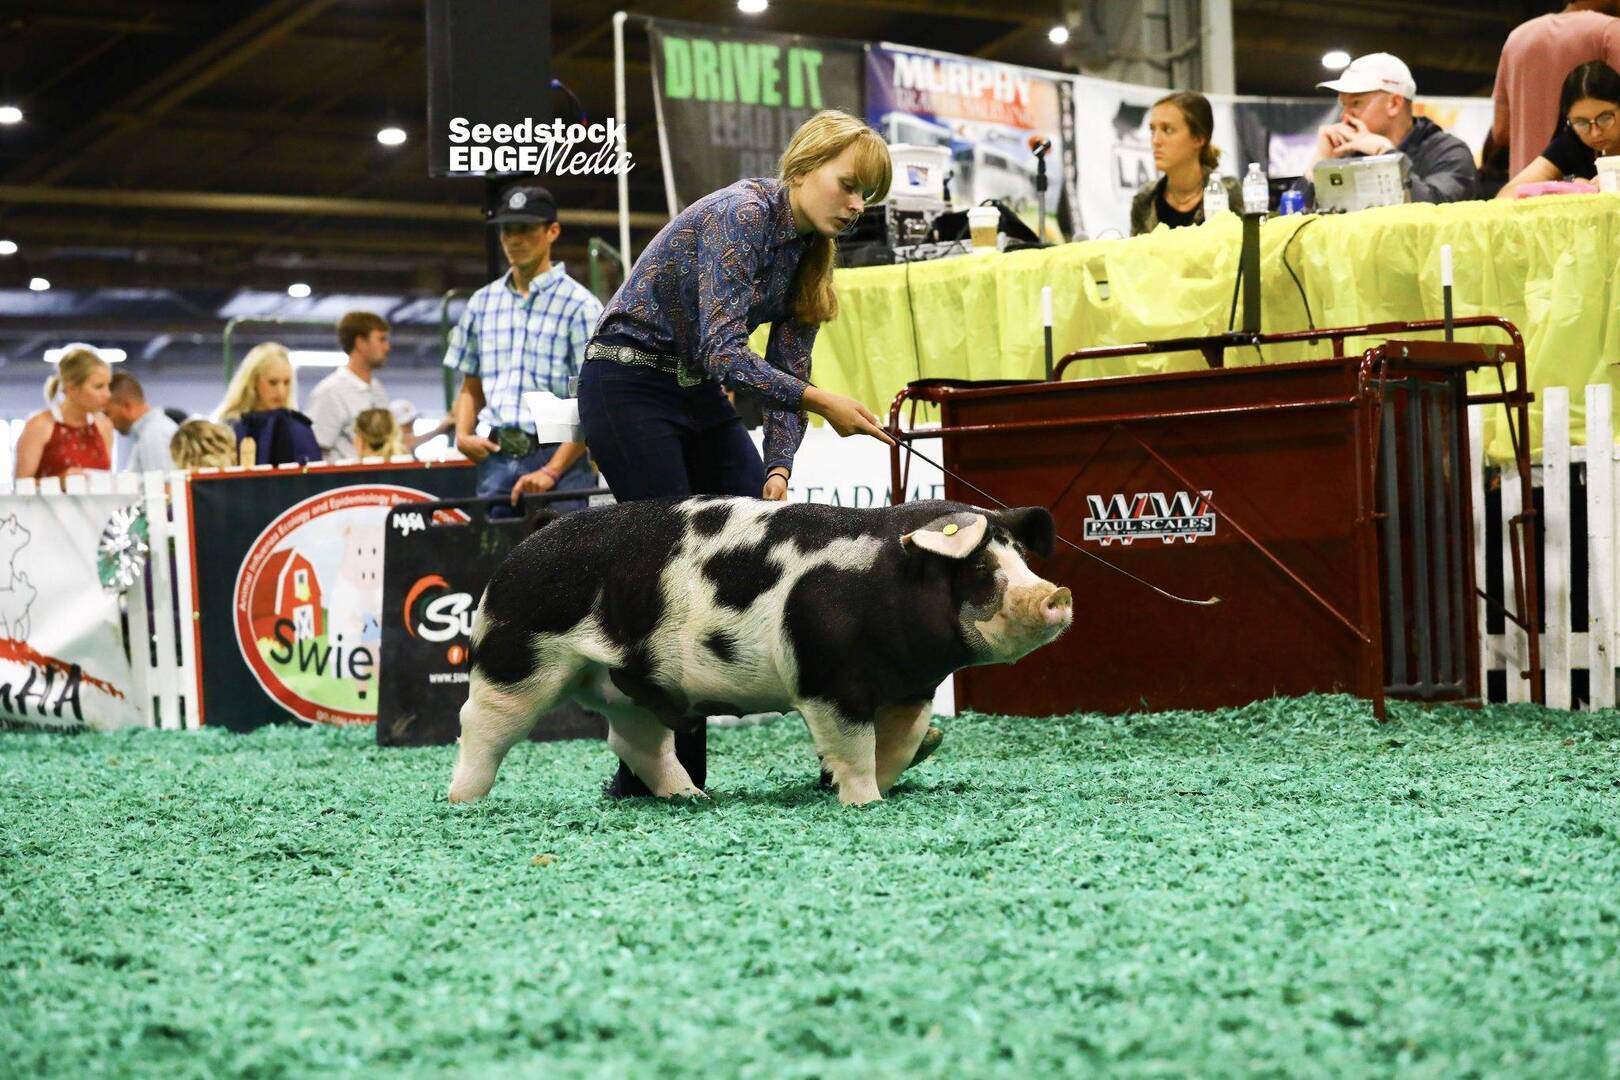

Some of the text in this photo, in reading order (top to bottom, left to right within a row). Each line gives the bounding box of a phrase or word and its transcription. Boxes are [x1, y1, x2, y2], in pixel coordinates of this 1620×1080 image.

[664, 36, 823, 109] DRIVE IT
[894, 53, 1031, 106] MURPHY
[1091, 518, 1210, 532] PAUL SCALES
[270, 618, 374, 681] Swie
